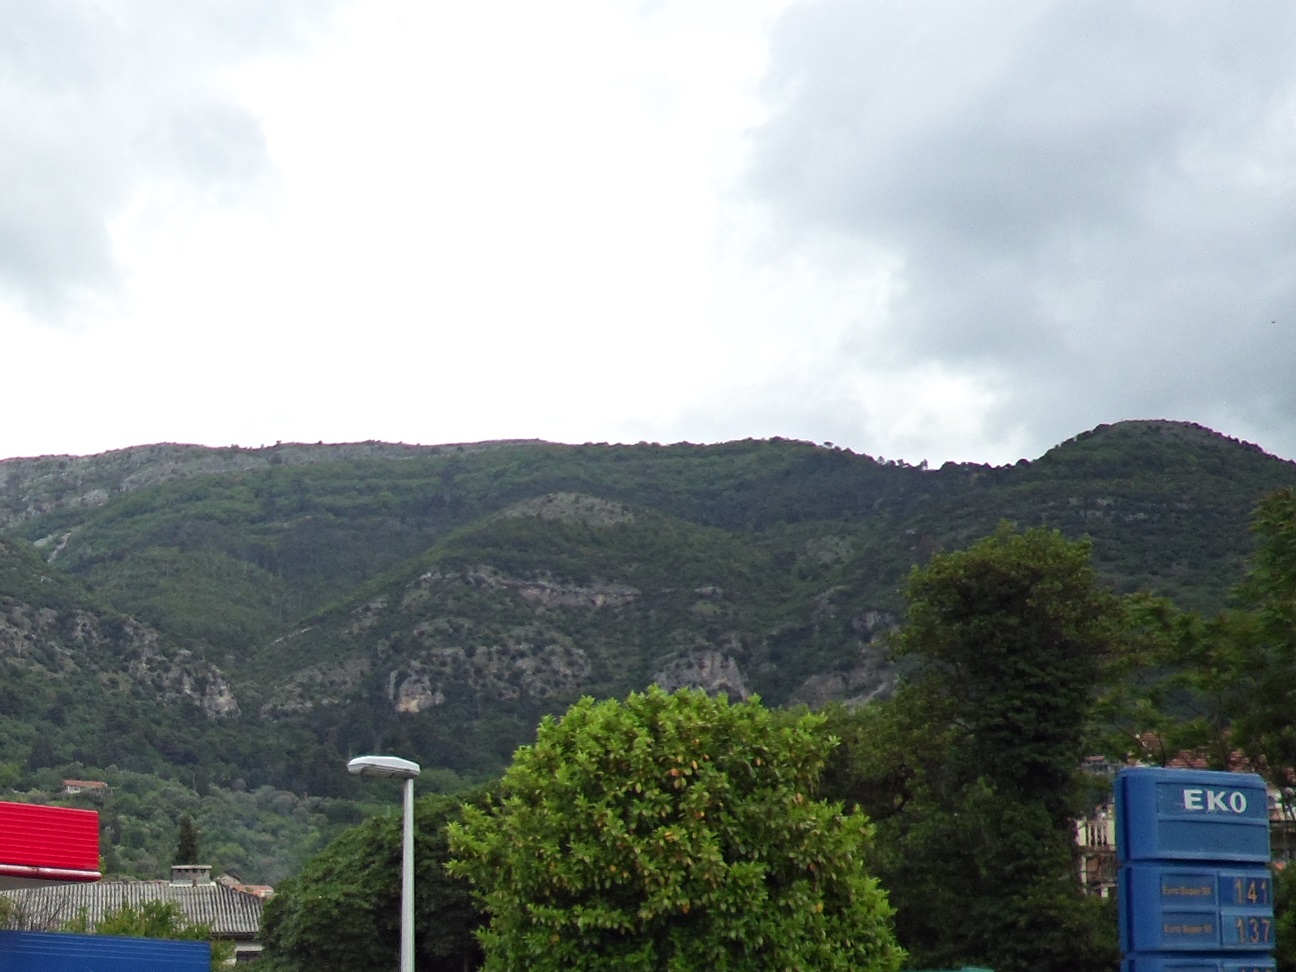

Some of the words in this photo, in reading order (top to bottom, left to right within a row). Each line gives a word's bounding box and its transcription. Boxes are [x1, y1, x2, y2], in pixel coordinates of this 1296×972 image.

[1183, 789, 1247, 813] EKO
[1235, 879, 1268, 904] 141
[1235, 916, 1271, 943] 137
